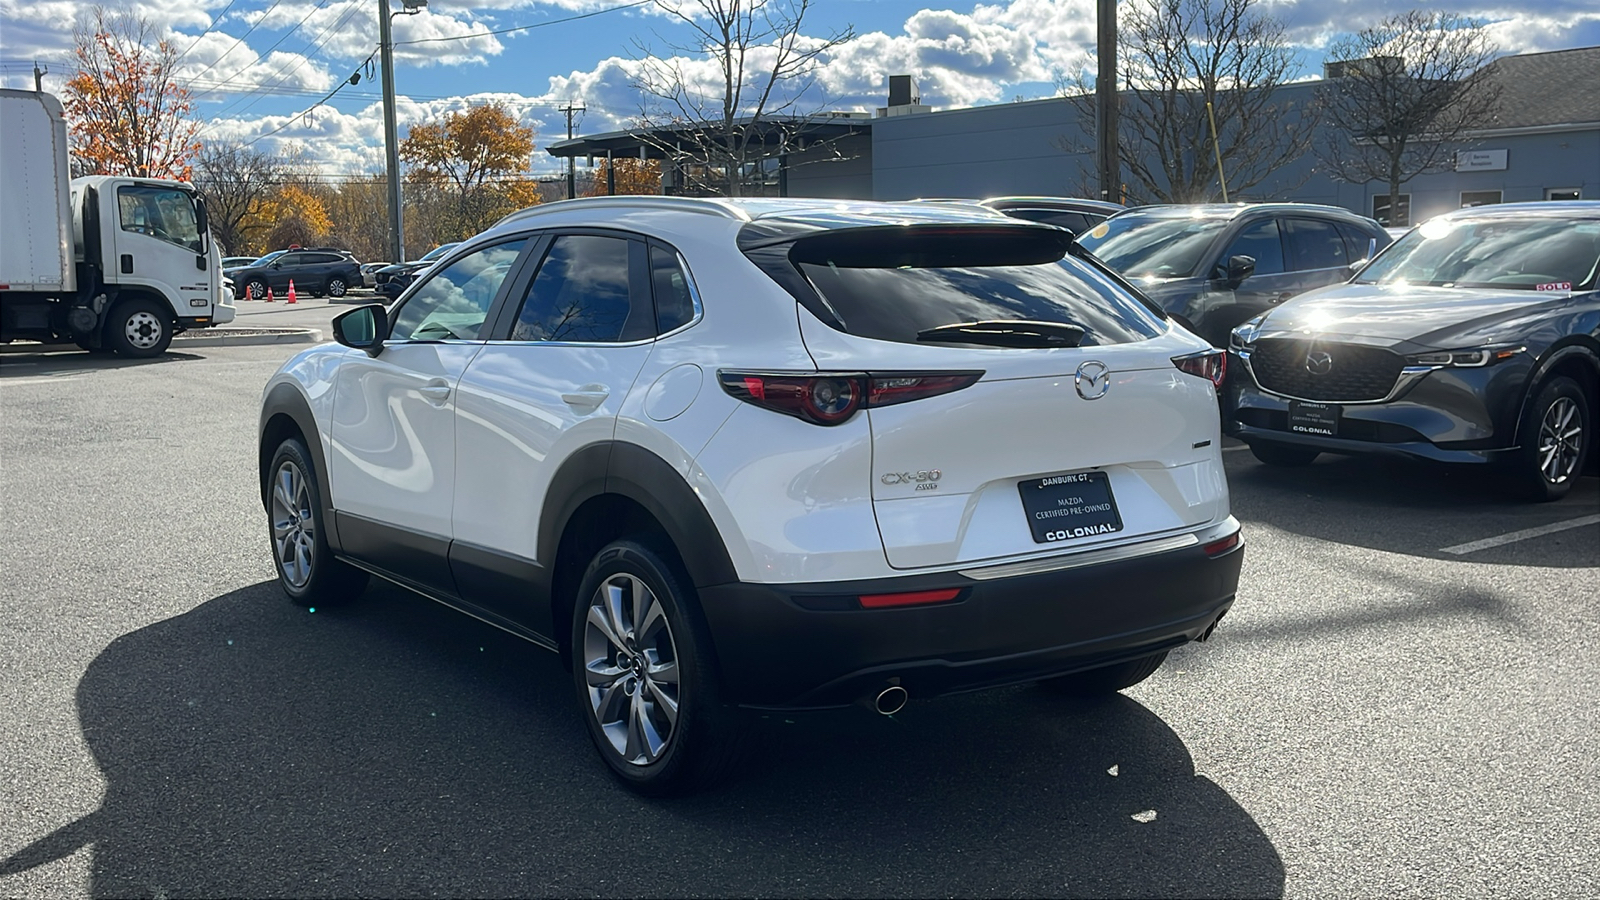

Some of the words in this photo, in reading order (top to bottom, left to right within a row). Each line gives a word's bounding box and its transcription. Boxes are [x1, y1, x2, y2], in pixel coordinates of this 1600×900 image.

[1537, 283, 1570, 291] SOLD
[1292, 425, 1333, 435] COLONIAL
[880, 468, 942, 486] CX-30
[1078, 473, 1088, 482] CT
[1057, 496, 1084, 506] MAZDA
[1035, 508, 1069, 520] CERTIFIED
[1070, 503, 1111, 515] PRE-OWNED
[1045, 523, 1116, 541] COLONIAL
